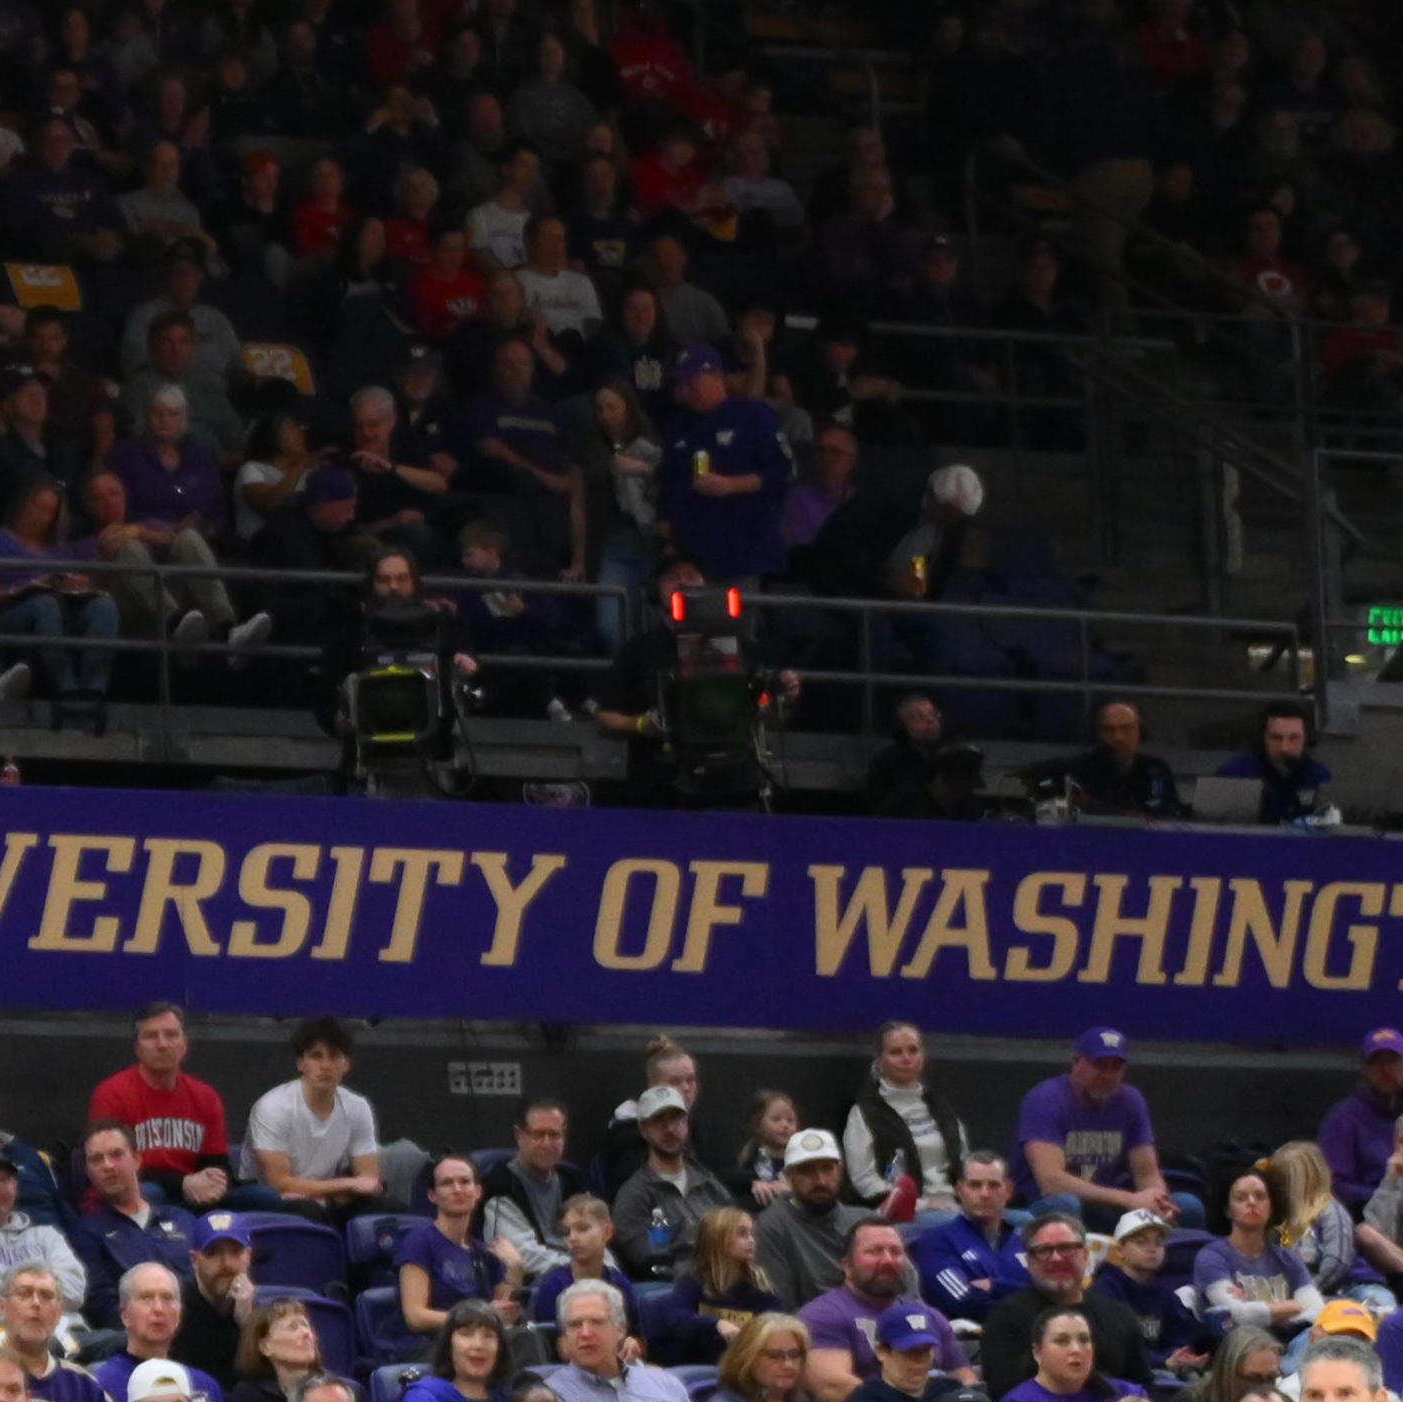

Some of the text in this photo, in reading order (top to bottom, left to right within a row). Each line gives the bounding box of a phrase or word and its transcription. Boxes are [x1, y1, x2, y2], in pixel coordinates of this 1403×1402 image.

[1368, 606, 1403, 645] EX
[593, 859, 770, 973] OF
[807, 863, 1403, 990] WASHING
[135, 1116, 206, 1152] WISCONSIN
